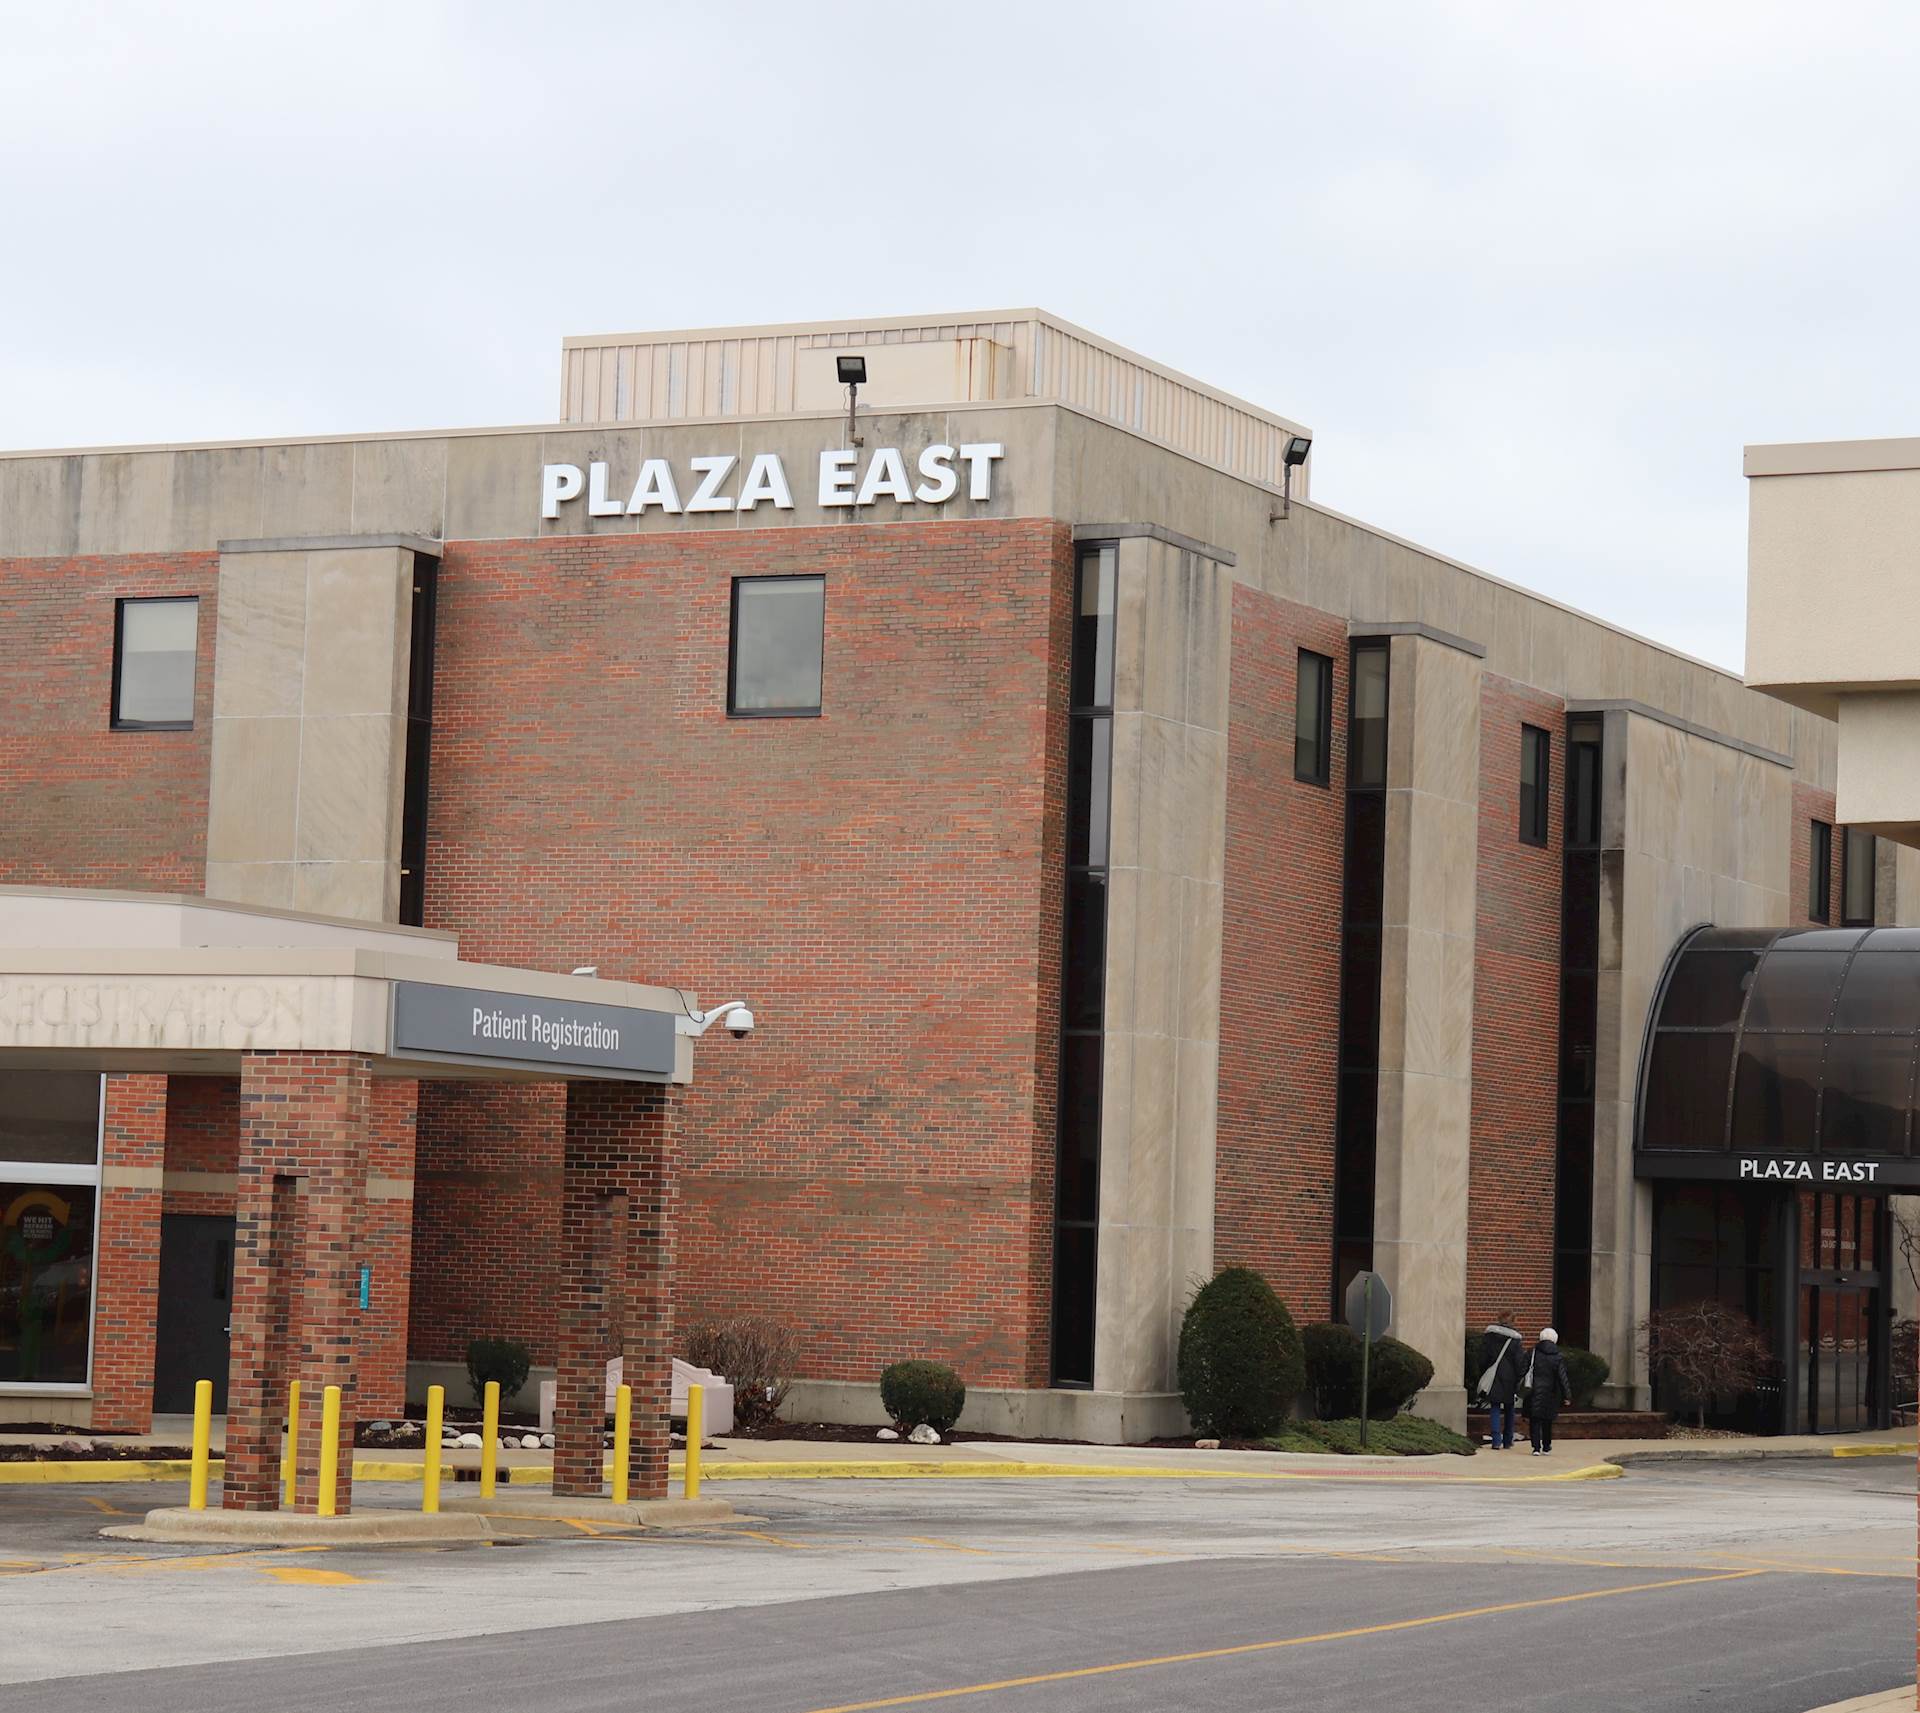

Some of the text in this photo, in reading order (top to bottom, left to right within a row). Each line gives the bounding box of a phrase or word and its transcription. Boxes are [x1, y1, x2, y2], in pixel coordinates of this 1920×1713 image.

[541, 443, 1005, 519] PLAZA EAST
[472, 1007, 620, 1051] Patient Registration
[1739, 1159, 1880, 1181] PLAZA EAST
